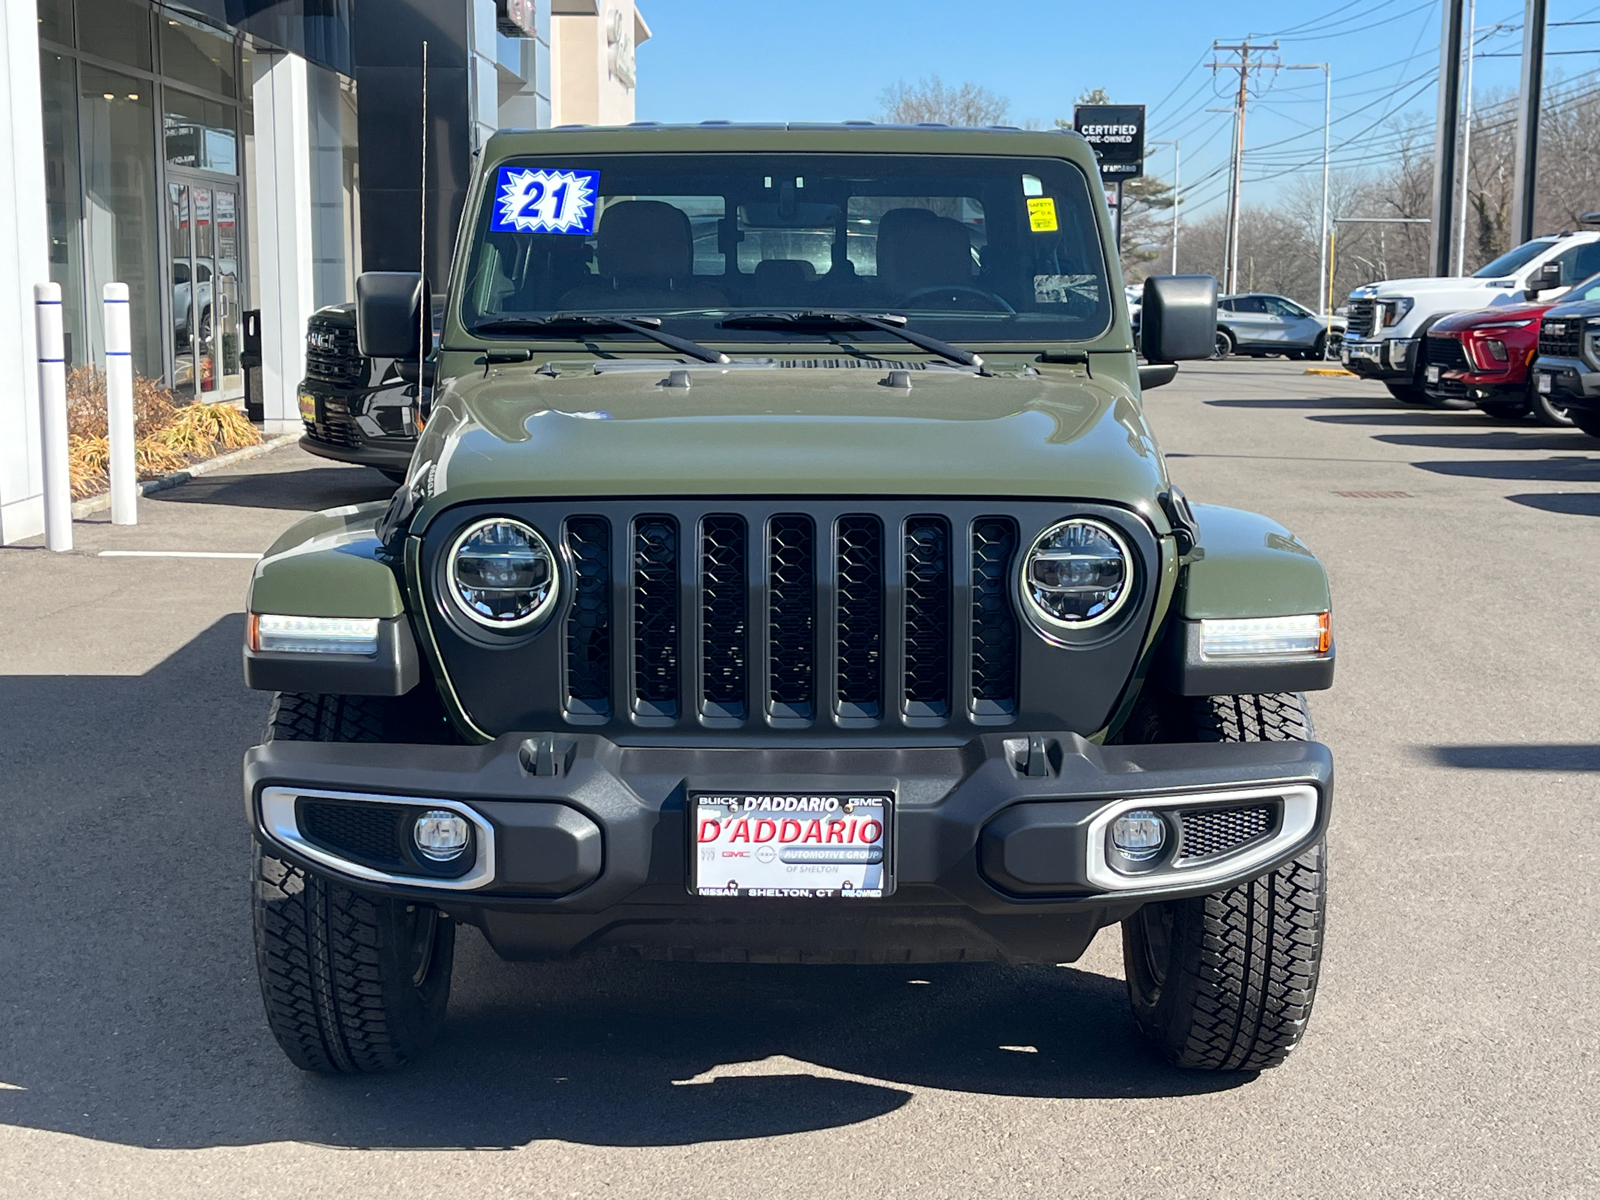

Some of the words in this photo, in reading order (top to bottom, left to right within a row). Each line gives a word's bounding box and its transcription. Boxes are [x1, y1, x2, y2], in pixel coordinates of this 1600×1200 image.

[1081, 125, 1137, 135] CERTIFIED
[517, 181, 570, 219] 21
[699, 797, 738, 805] BUICK
[743, 796, 839, 812] D'ADDARIO
[849, 798, 882, 806] GMC
[697, 818, 883, 844] D'ADDARIO
[784, 850, 845, 859] AUTOMOTIVE
[846, 850, 880, 859] GROUP
[699, 888, 738, 896] NISSAN
[748, 889, 813, 898] SHELTON,
[815, 889, 834, 897] CT
